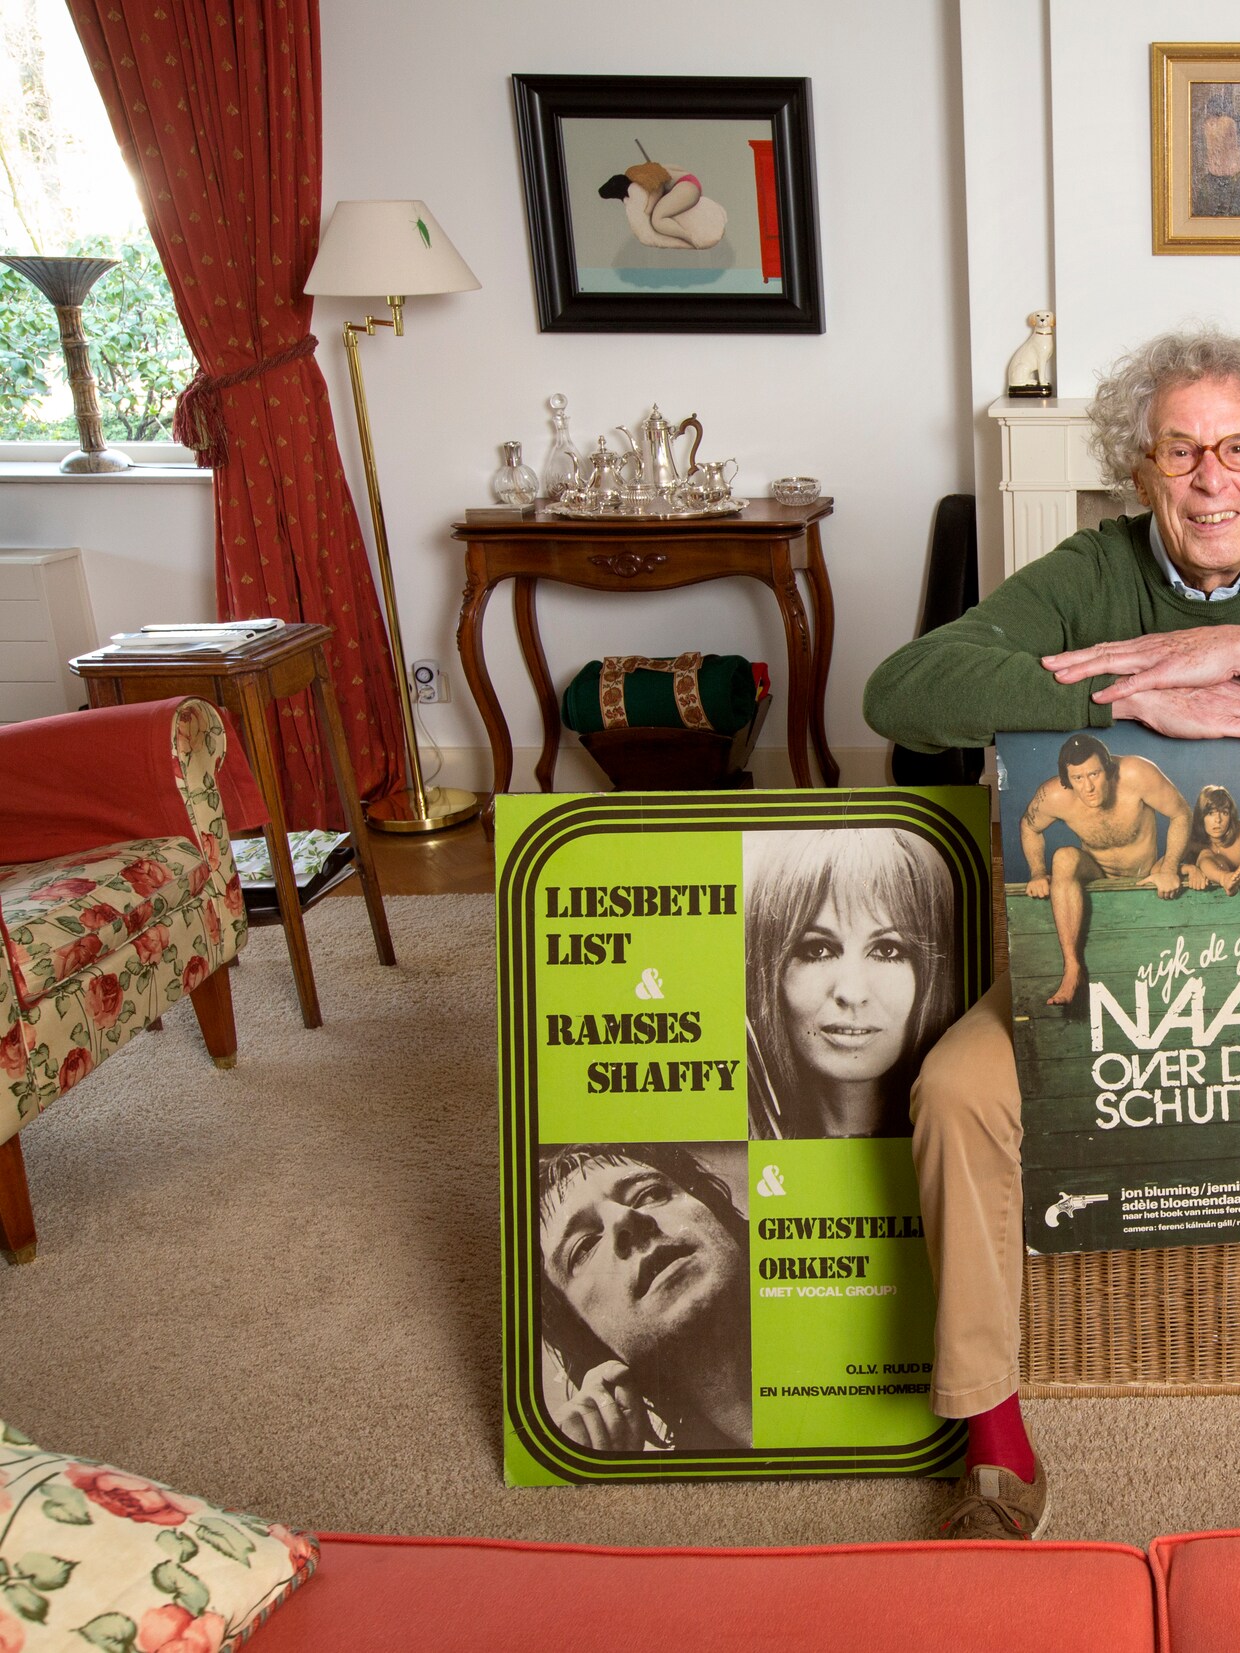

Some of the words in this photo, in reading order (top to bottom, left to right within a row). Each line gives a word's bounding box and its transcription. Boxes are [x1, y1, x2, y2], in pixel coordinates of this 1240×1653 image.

[545, 884, 737, 919] LIESBETH
[545, 933, 632, 966] LIST
[1200, 932, 1228, 968] de
[635, 967, 665, 1000] &
[546, 1011, 702, 1047] RAMSES
[587, 1059, 740, 1094] SHAFFY
[1091, 1048, 1206, 1090] OVER
[757, 1164, 787, 1197] &
[1120, 1187, 1142, 1200] jon
[1145, 1184, 1199, 1197] bluming
[1122, 1199, 1158, 1211] adèle
[1122, 1212, 1143, 1220] naar
[1144, 1210, 1159, 1219] het
[1160, 1209, 1183, 1218] boek
[1184, 1209, 1201, 1217] van
[1202, 1207, 1225, 1215] rinus
[1123, 1225, 1157, 1233] camera:
[758, 1256, 870, 1280] ORKEST
[759, 1287, 793, 1298] (MET
[796, 1286, 843, 1297] VOCAL
[845, 1285, 897, 1297] GROUP)
[846, 1364, 878, 1375] O.L.V.
[883, 1363, 920, 1374] RUUD
[759, 1386, 778, 1397] EN
[781, 1386, 820, 1397] HANS
[819, 1385, 847, 1396] VAN
[849, 1385, 876, 1396] DEN
[877, 1383, 931, 1395] HOMBER
